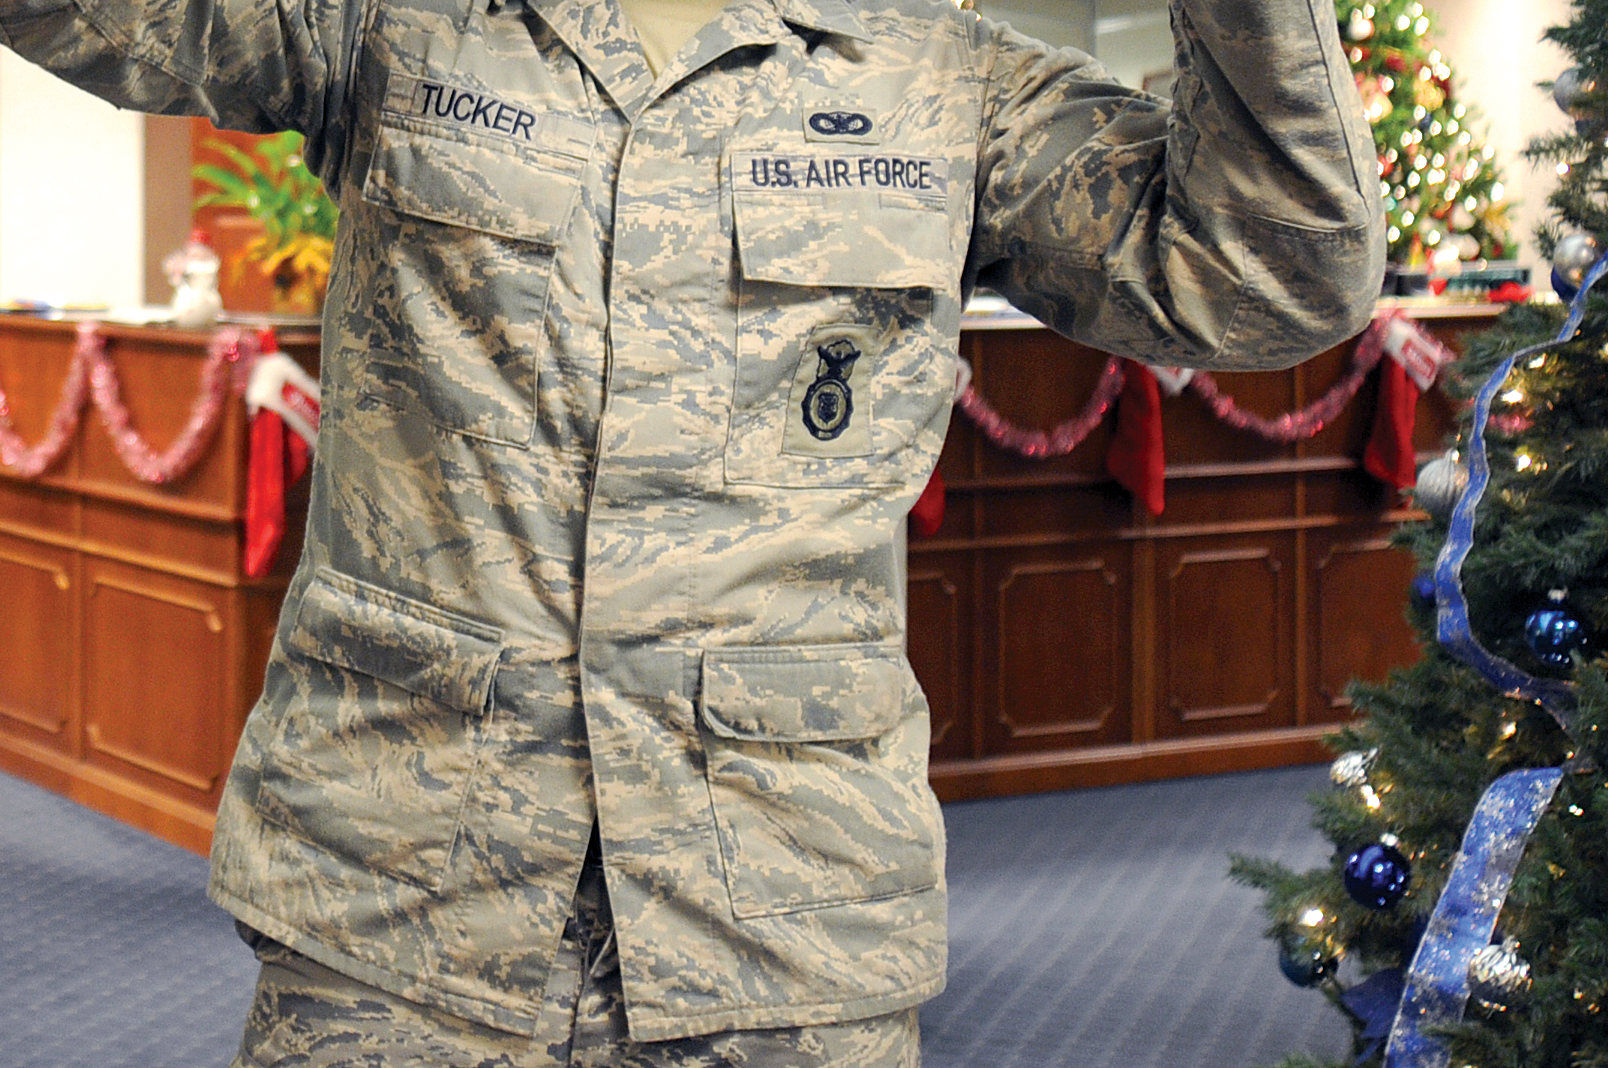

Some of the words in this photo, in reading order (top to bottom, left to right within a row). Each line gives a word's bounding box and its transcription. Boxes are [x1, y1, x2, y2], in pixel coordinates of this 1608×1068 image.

[422, 83, 537, 141] TUCKER
[751, 157, 799, 189] U.S.
[806, 158, 853, 188] AIR
[858, 158, 932, 190] FORCE
